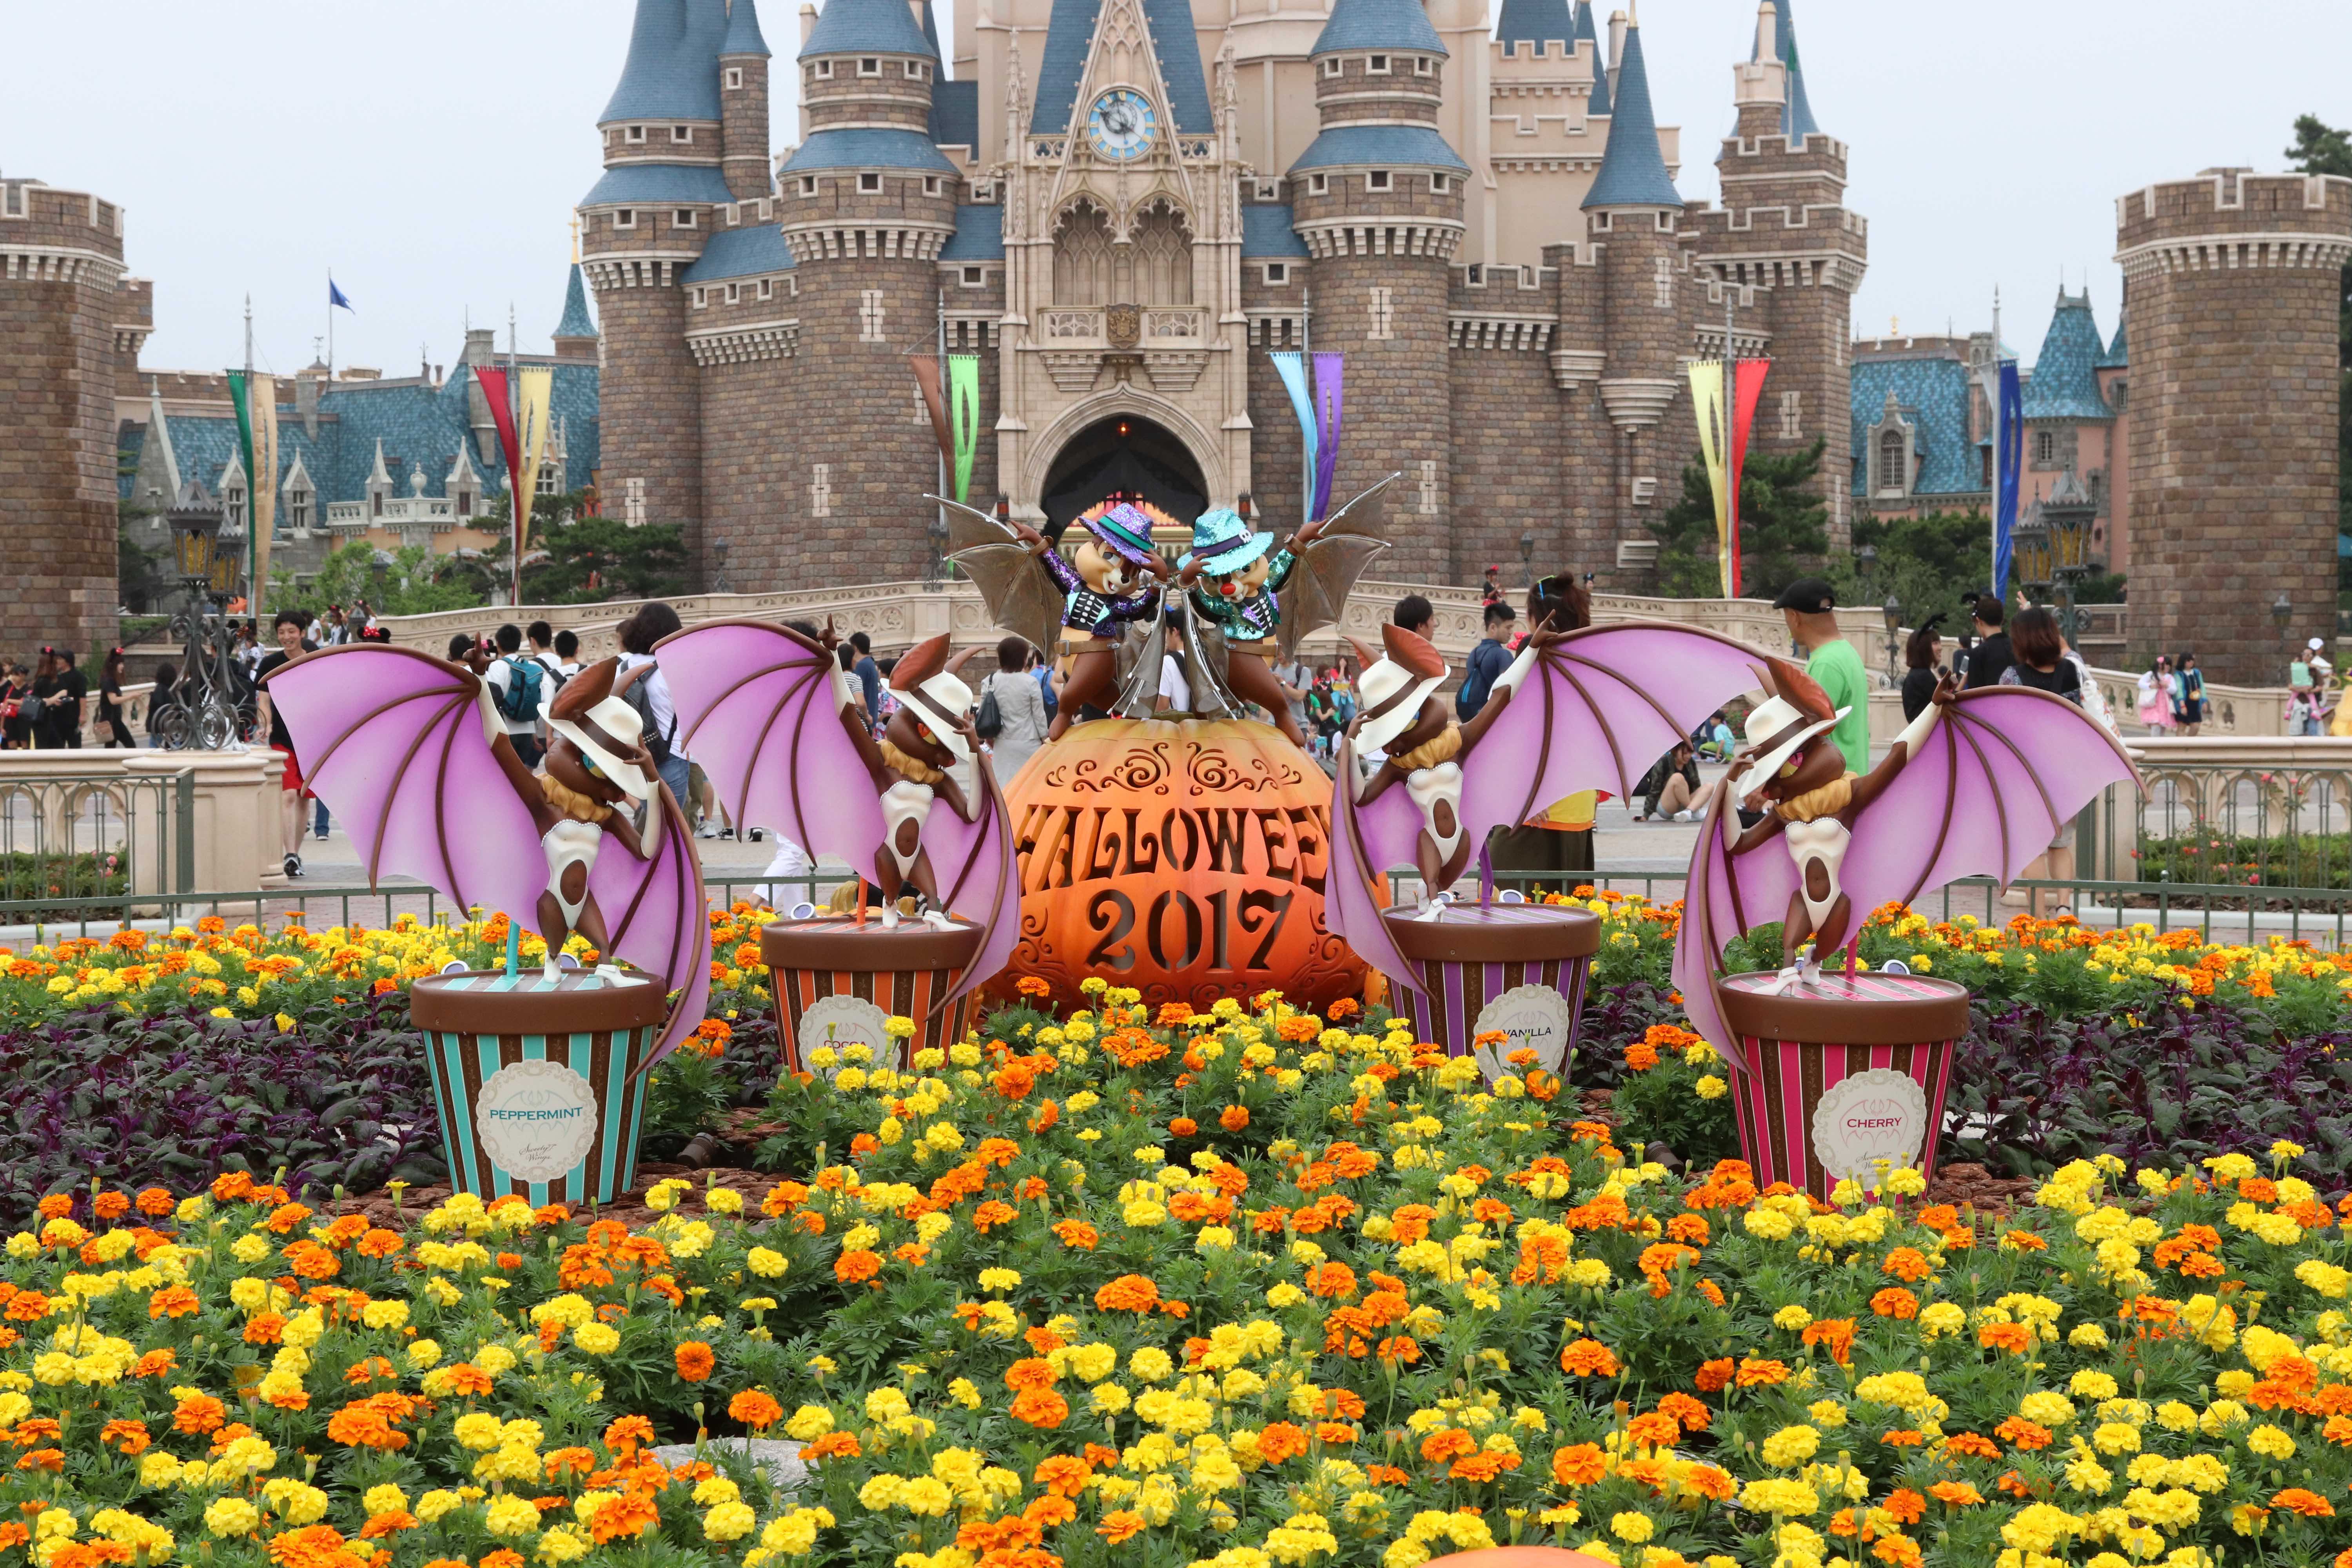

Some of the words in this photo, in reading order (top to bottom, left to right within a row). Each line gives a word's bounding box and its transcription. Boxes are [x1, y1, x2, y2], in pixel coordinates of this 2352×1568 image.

[1014, 804, 1330, 897] HALLOWEE
[1084, 888, 1295, 974] 2017
[490, 1106, 583, 1120] PEPPERMINT
[1847, 1117, 1902, 1128] CHERRY
